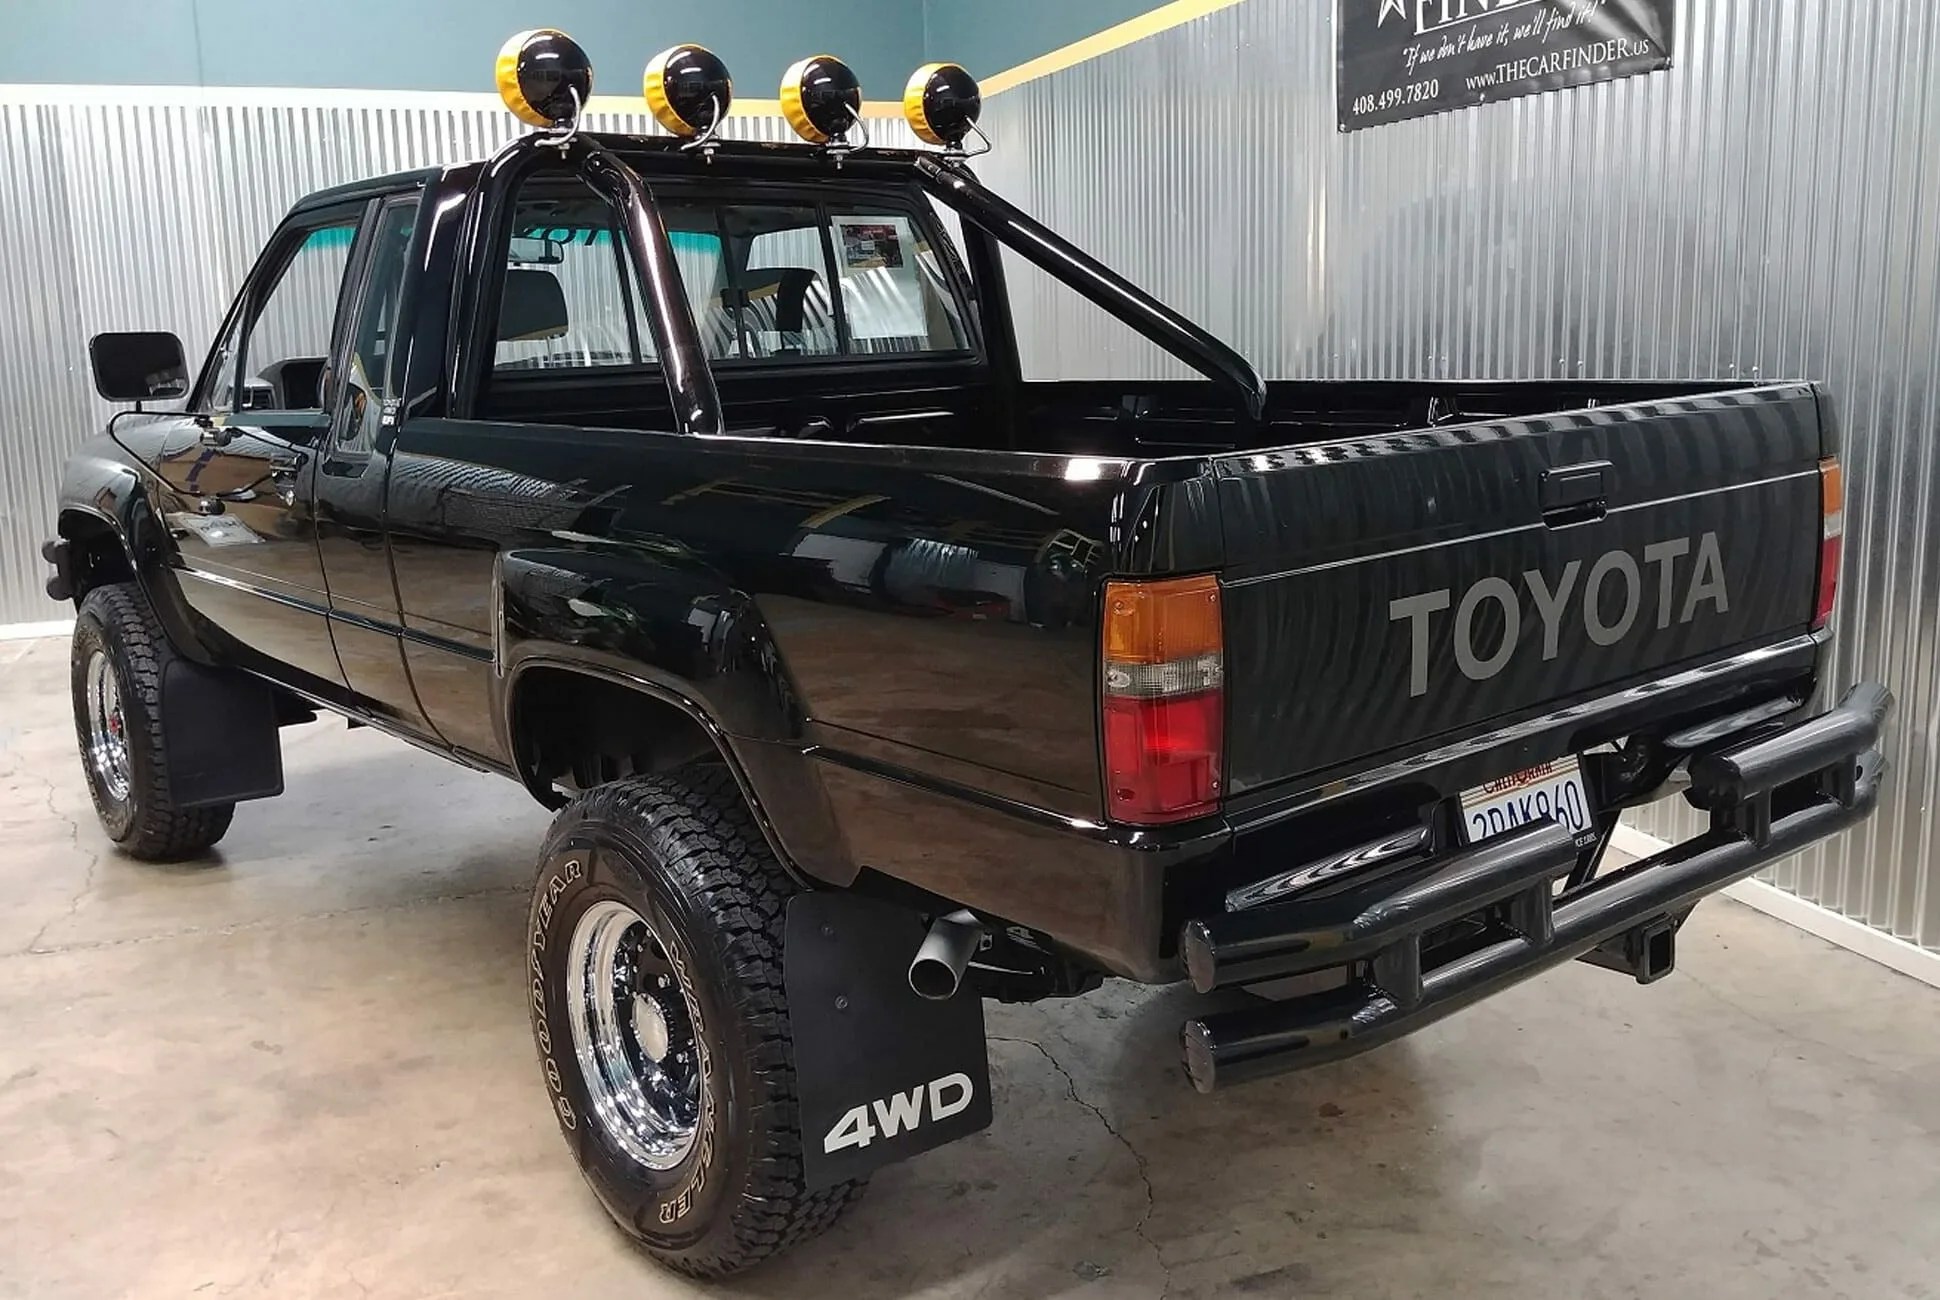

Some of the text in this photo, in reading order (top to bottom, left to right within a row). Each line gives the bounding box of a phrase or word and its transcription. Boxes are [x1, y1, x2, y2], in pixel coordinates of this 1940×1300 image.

[1419, 50, 1434, 65] we
[1437, 35, 1466, 60] don't
[1467, 24, 1493, 51] have
[1513, 8, 1545, 40] we'll
[1541, 2, 1576, 44] find
[1352, 79, 1439, 115] 408.499.7820
[1389, 531, 1730, 698] TOYOTA
[531, 858, 583, 1131] GOODYEAR
[824, 1072, 973, 1154] 4WD
